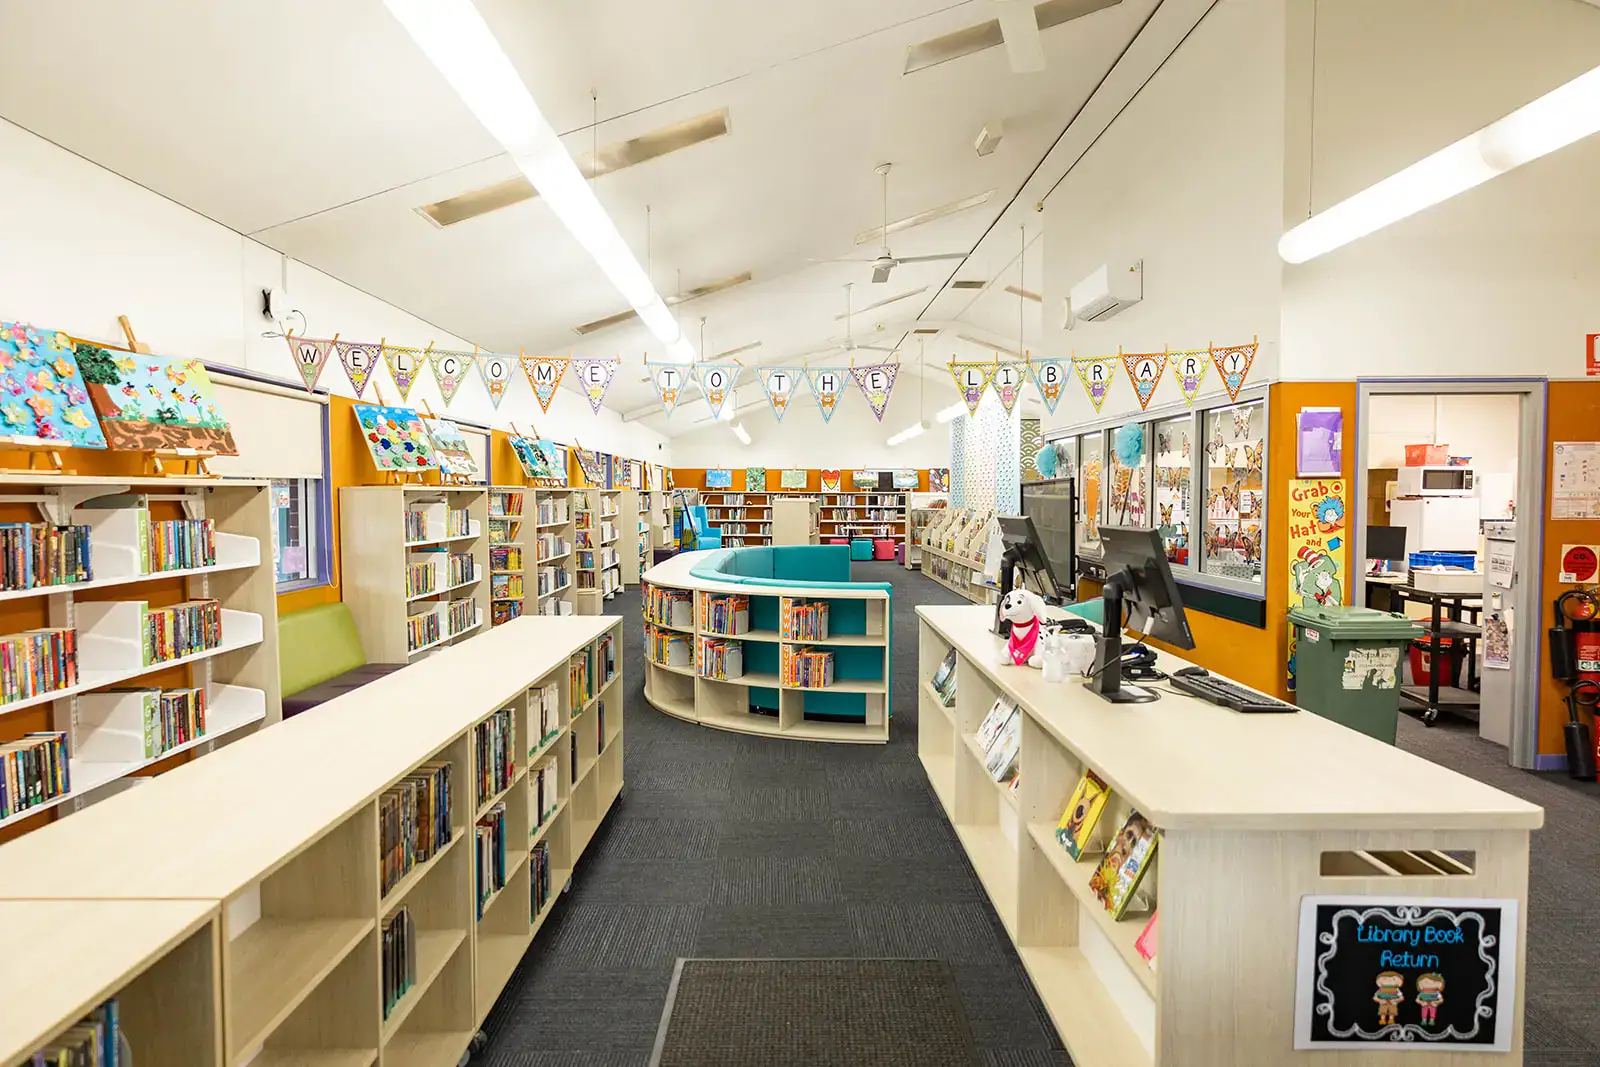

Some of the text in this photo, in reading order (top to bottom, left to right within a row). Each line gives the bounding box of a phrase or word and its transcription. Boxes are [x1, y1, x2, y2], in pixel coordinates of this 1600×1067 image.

[300, 349, 1240, 391] WELCOME TO THE LIBRARY
[1291, 481, 1329, 502] Grab
[1291, 508, 1312, 519] Your
[1290, 520, 1317, 539] Hat
[1306, 537, 1322, 547] and
[1356, 925, 1465, 947] Library Book
[1380, 950, 1439, 968] Return
